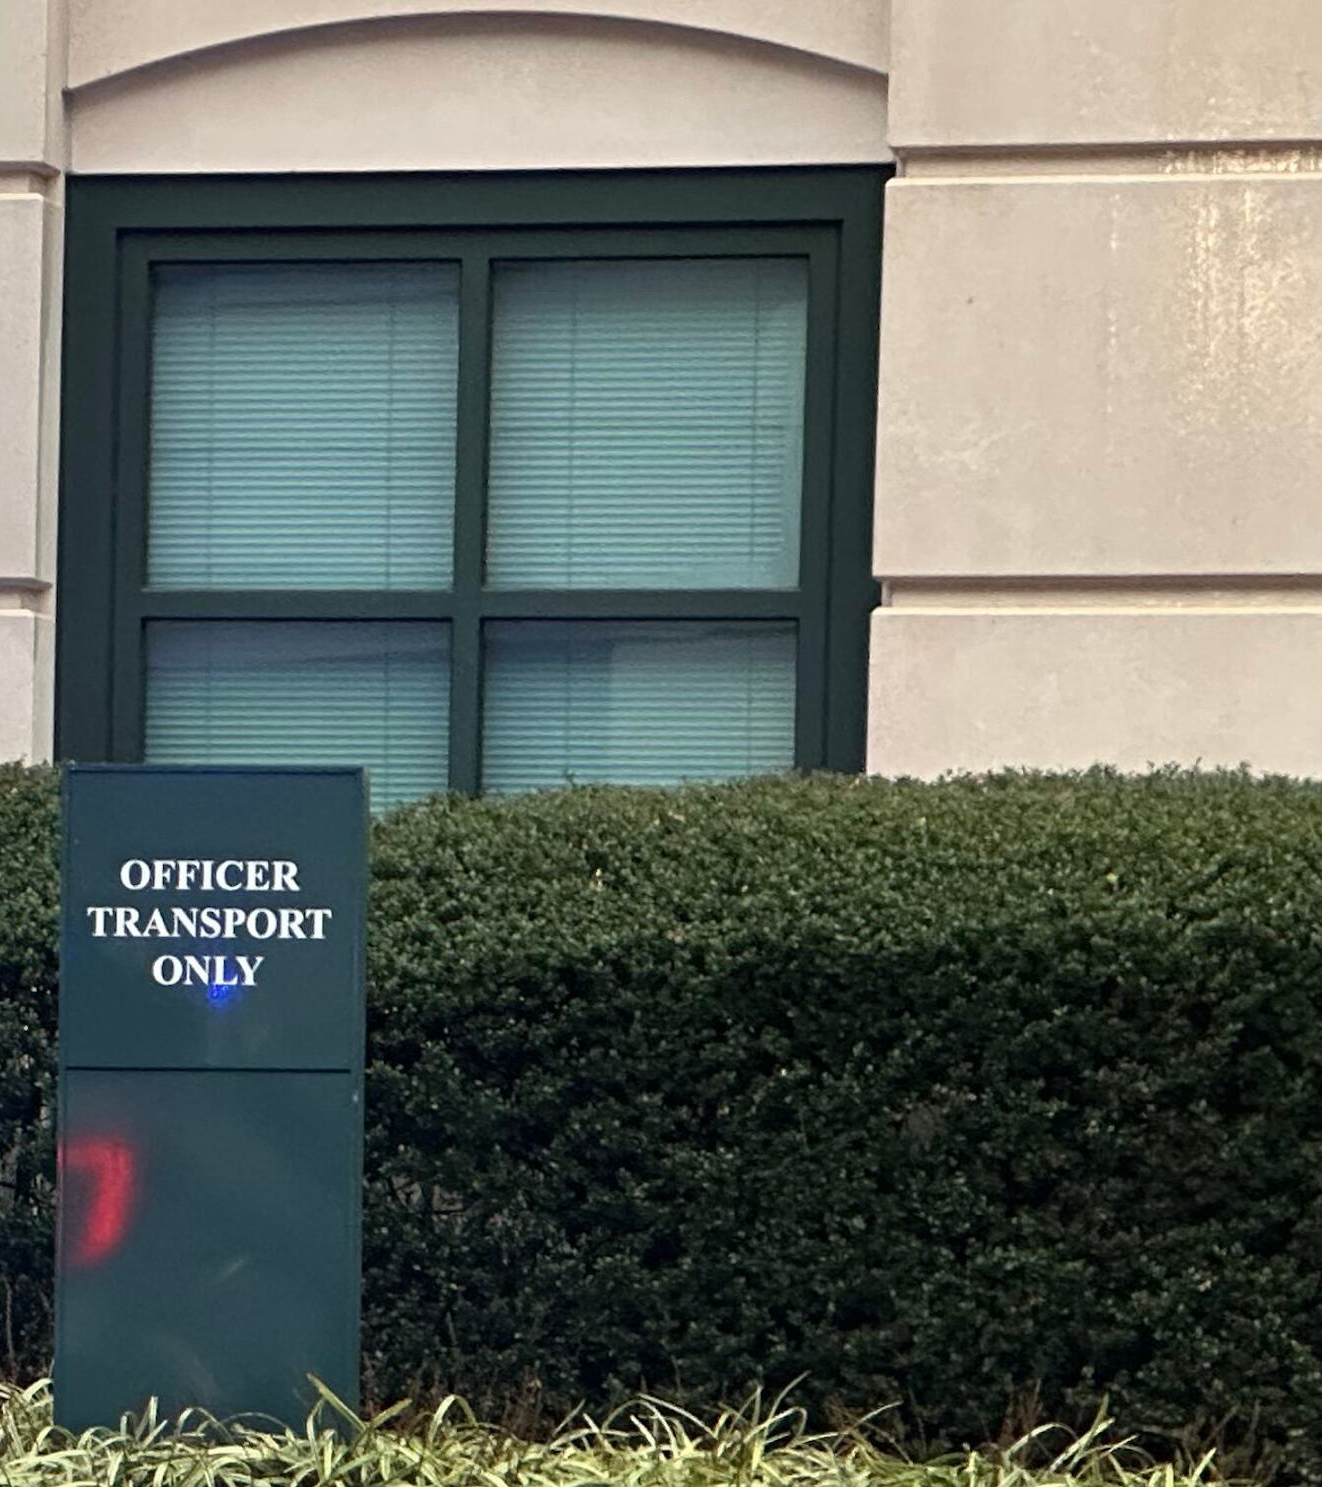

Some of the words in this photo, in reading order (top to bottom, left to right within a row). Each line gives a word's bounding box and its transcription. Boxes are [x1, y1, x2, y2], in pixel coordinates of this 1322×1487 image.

[120, 859, 300, 891] OFFICER
[87, 907, 332, 939] TRANSPORT
[153, 955, 264, 986] ONLY
